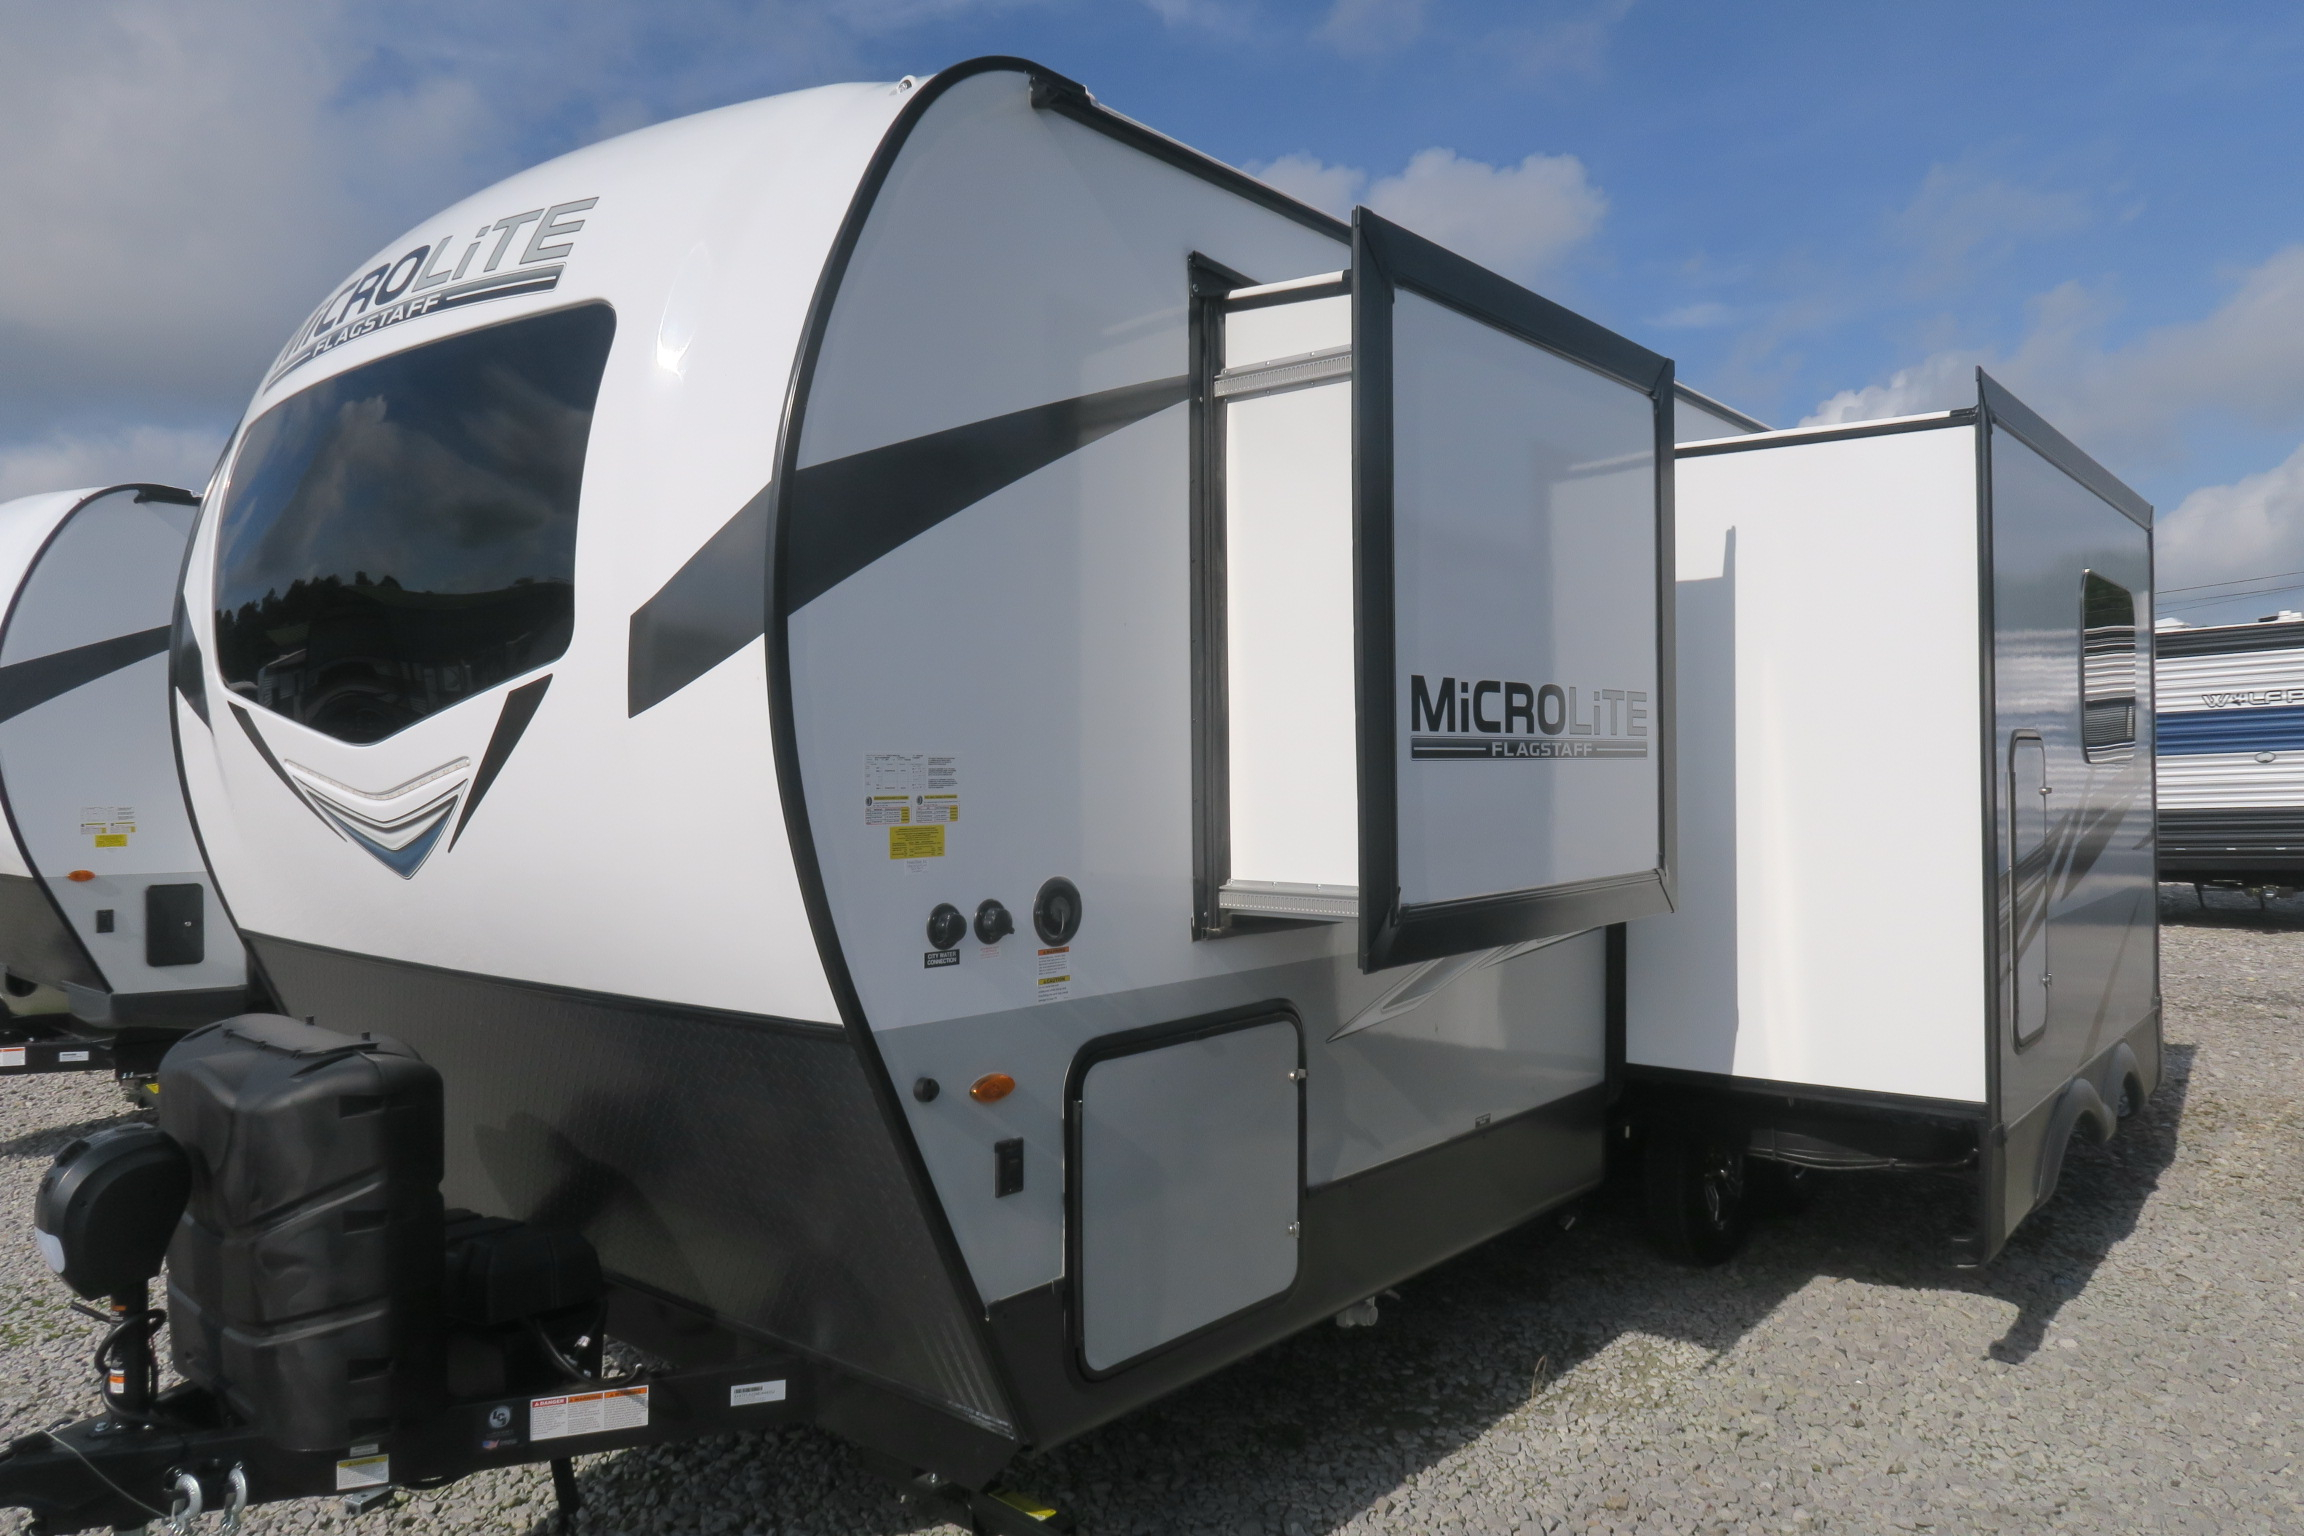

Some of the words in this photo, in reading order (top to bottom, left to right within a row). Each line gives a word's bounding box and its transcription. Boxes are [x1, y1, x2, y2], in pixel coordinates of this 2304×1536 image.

[312, 292, 442, 358] FLAGSTAFF
[1491, 740, 1593, 758] FLAGSTAFF
[939, 951, 957, 959] WATER
[927, 957, 957, 966] CONNECTION
[1046, 976, 1066, 985] CAUTION
[539, 1398, 565, 1407] DANGER
